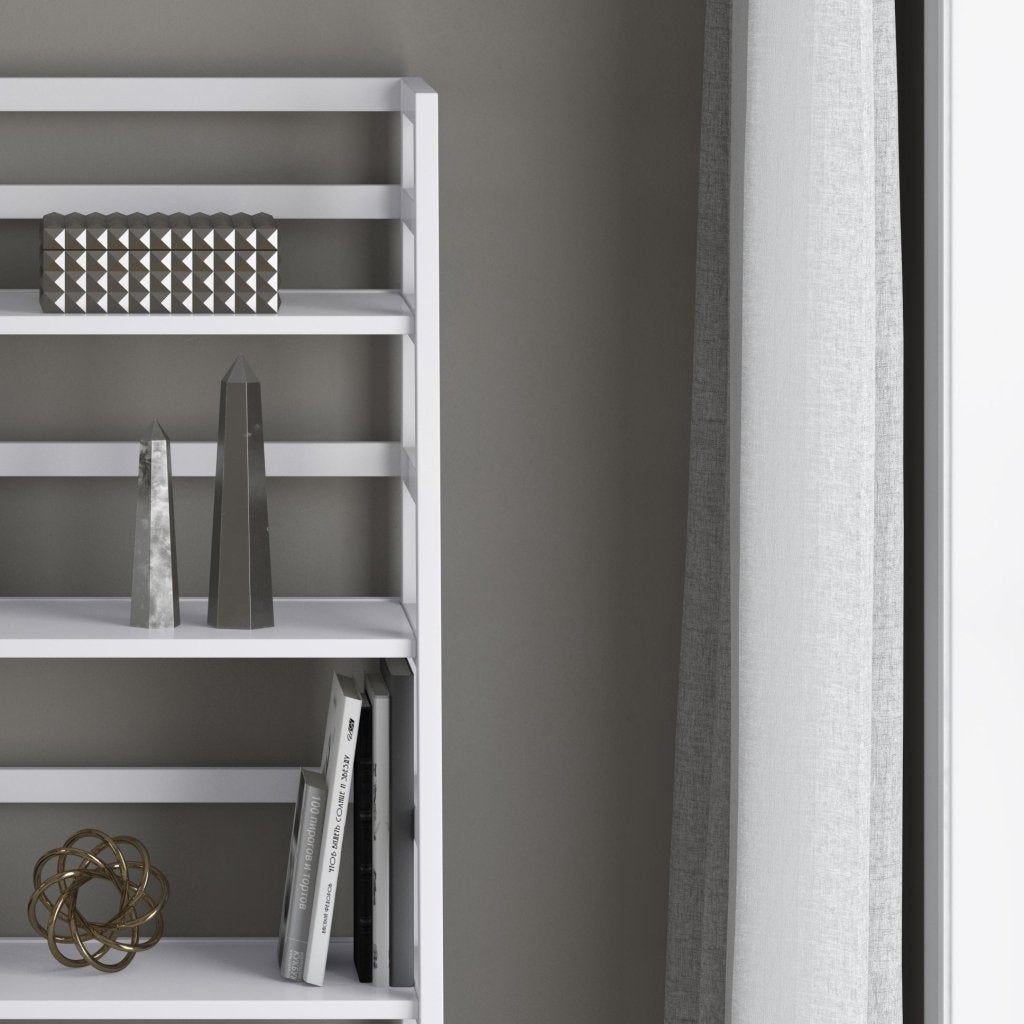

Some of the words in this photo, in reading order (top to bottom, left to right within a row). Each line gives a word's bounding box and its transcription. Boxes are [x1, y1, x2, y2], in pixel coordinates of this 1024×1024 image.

[310, 796, 320, 814] 100
[305, 816, 318, 861] пирогов
[299, 875, 309, 910] тортов
